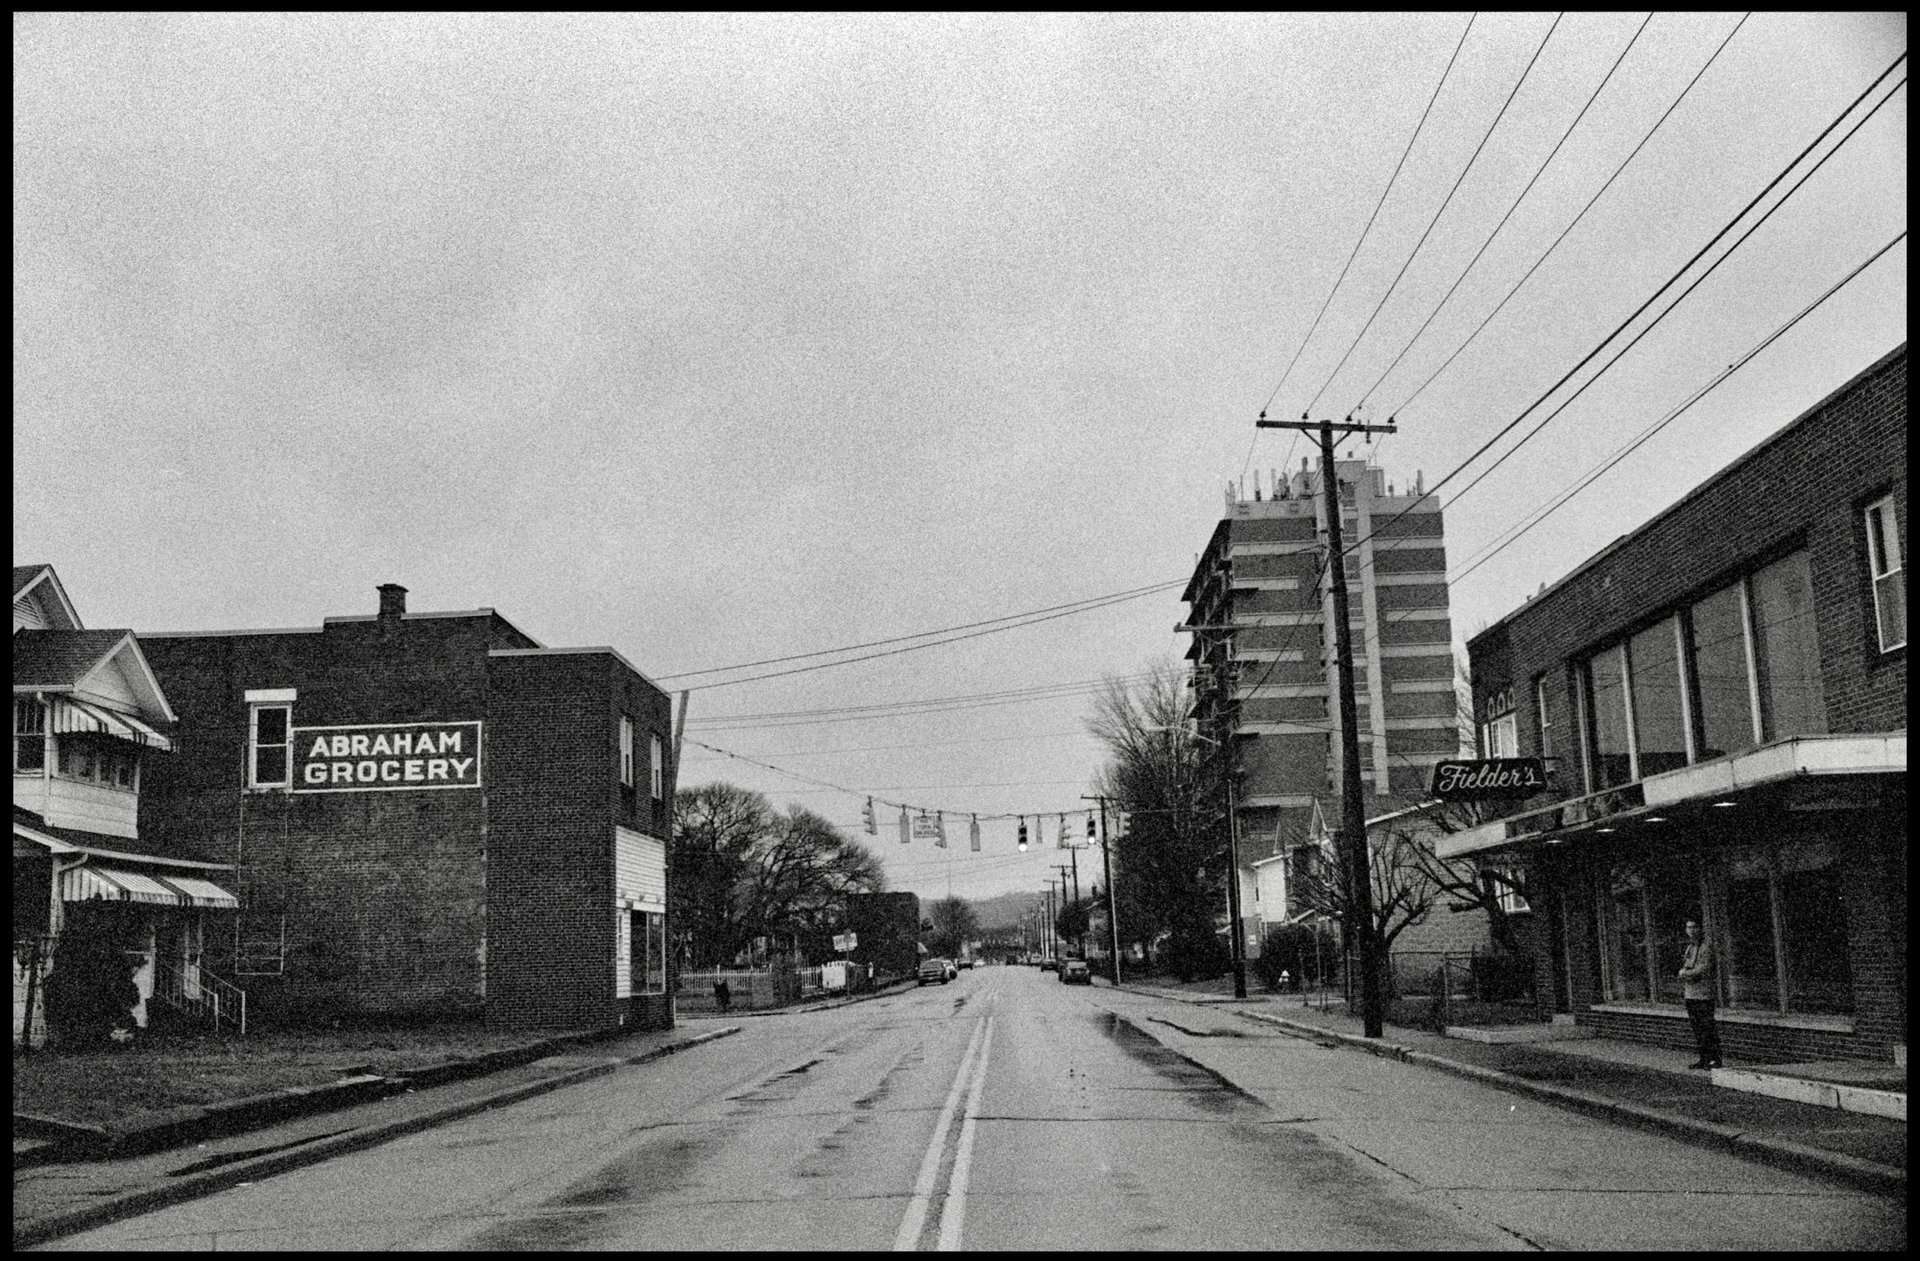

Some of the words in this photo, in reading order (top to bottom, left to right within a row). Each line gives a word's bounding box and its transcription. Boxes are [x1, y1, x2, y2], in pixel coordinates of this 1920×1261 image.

[309, 732, 461, 757] ABRAHAM
[304, 758, 474, 784] GROCERY
[1440, 763, 1542, 792] Fielder's
